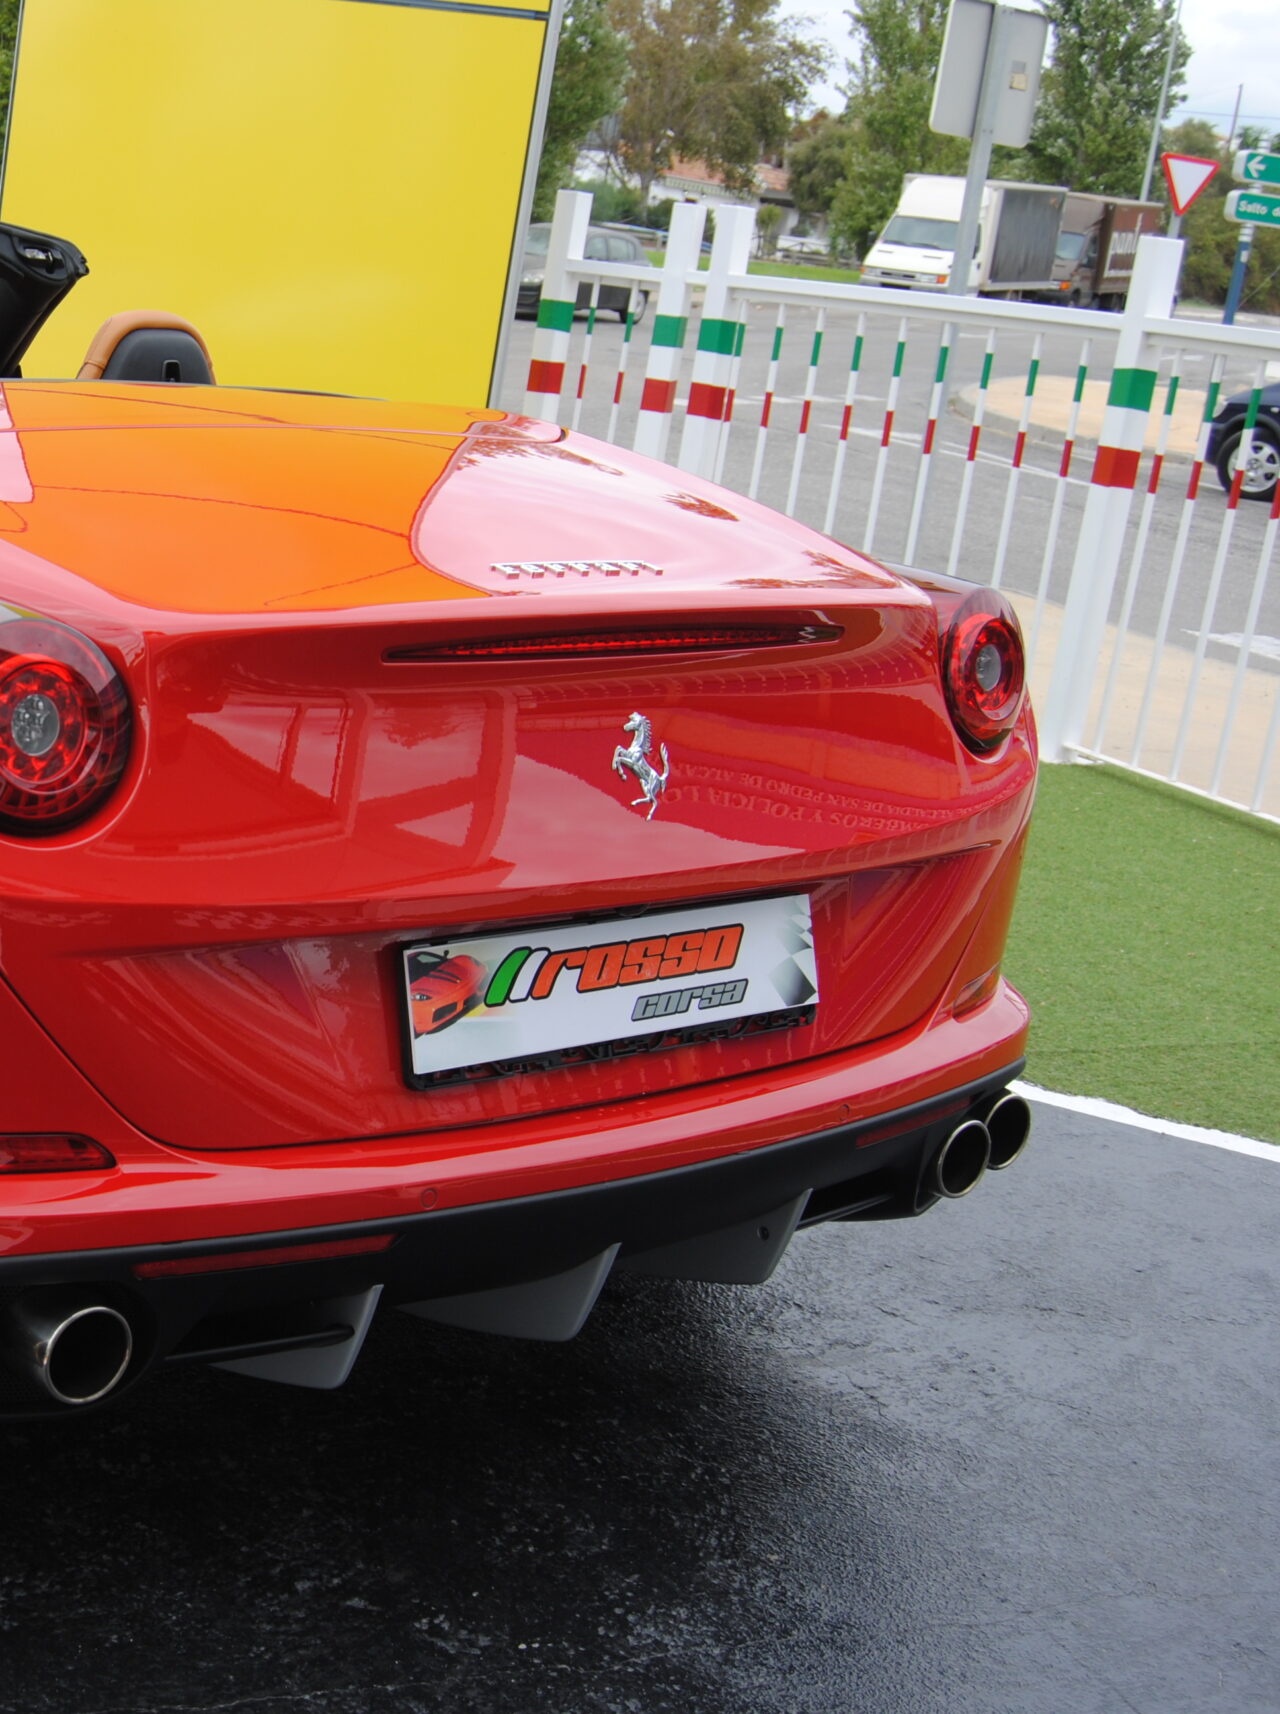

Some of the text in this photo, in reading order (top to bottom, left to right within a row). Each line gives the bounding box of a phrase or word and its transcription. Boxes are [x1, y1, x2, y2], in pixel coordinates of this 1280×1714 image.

[706, 786, 805, 822] POLICIA
[766, 778, 824, 802] PEDRO
[530, 923, 744, 1001] rosso
[631, 978, 749, 1022] corsa
